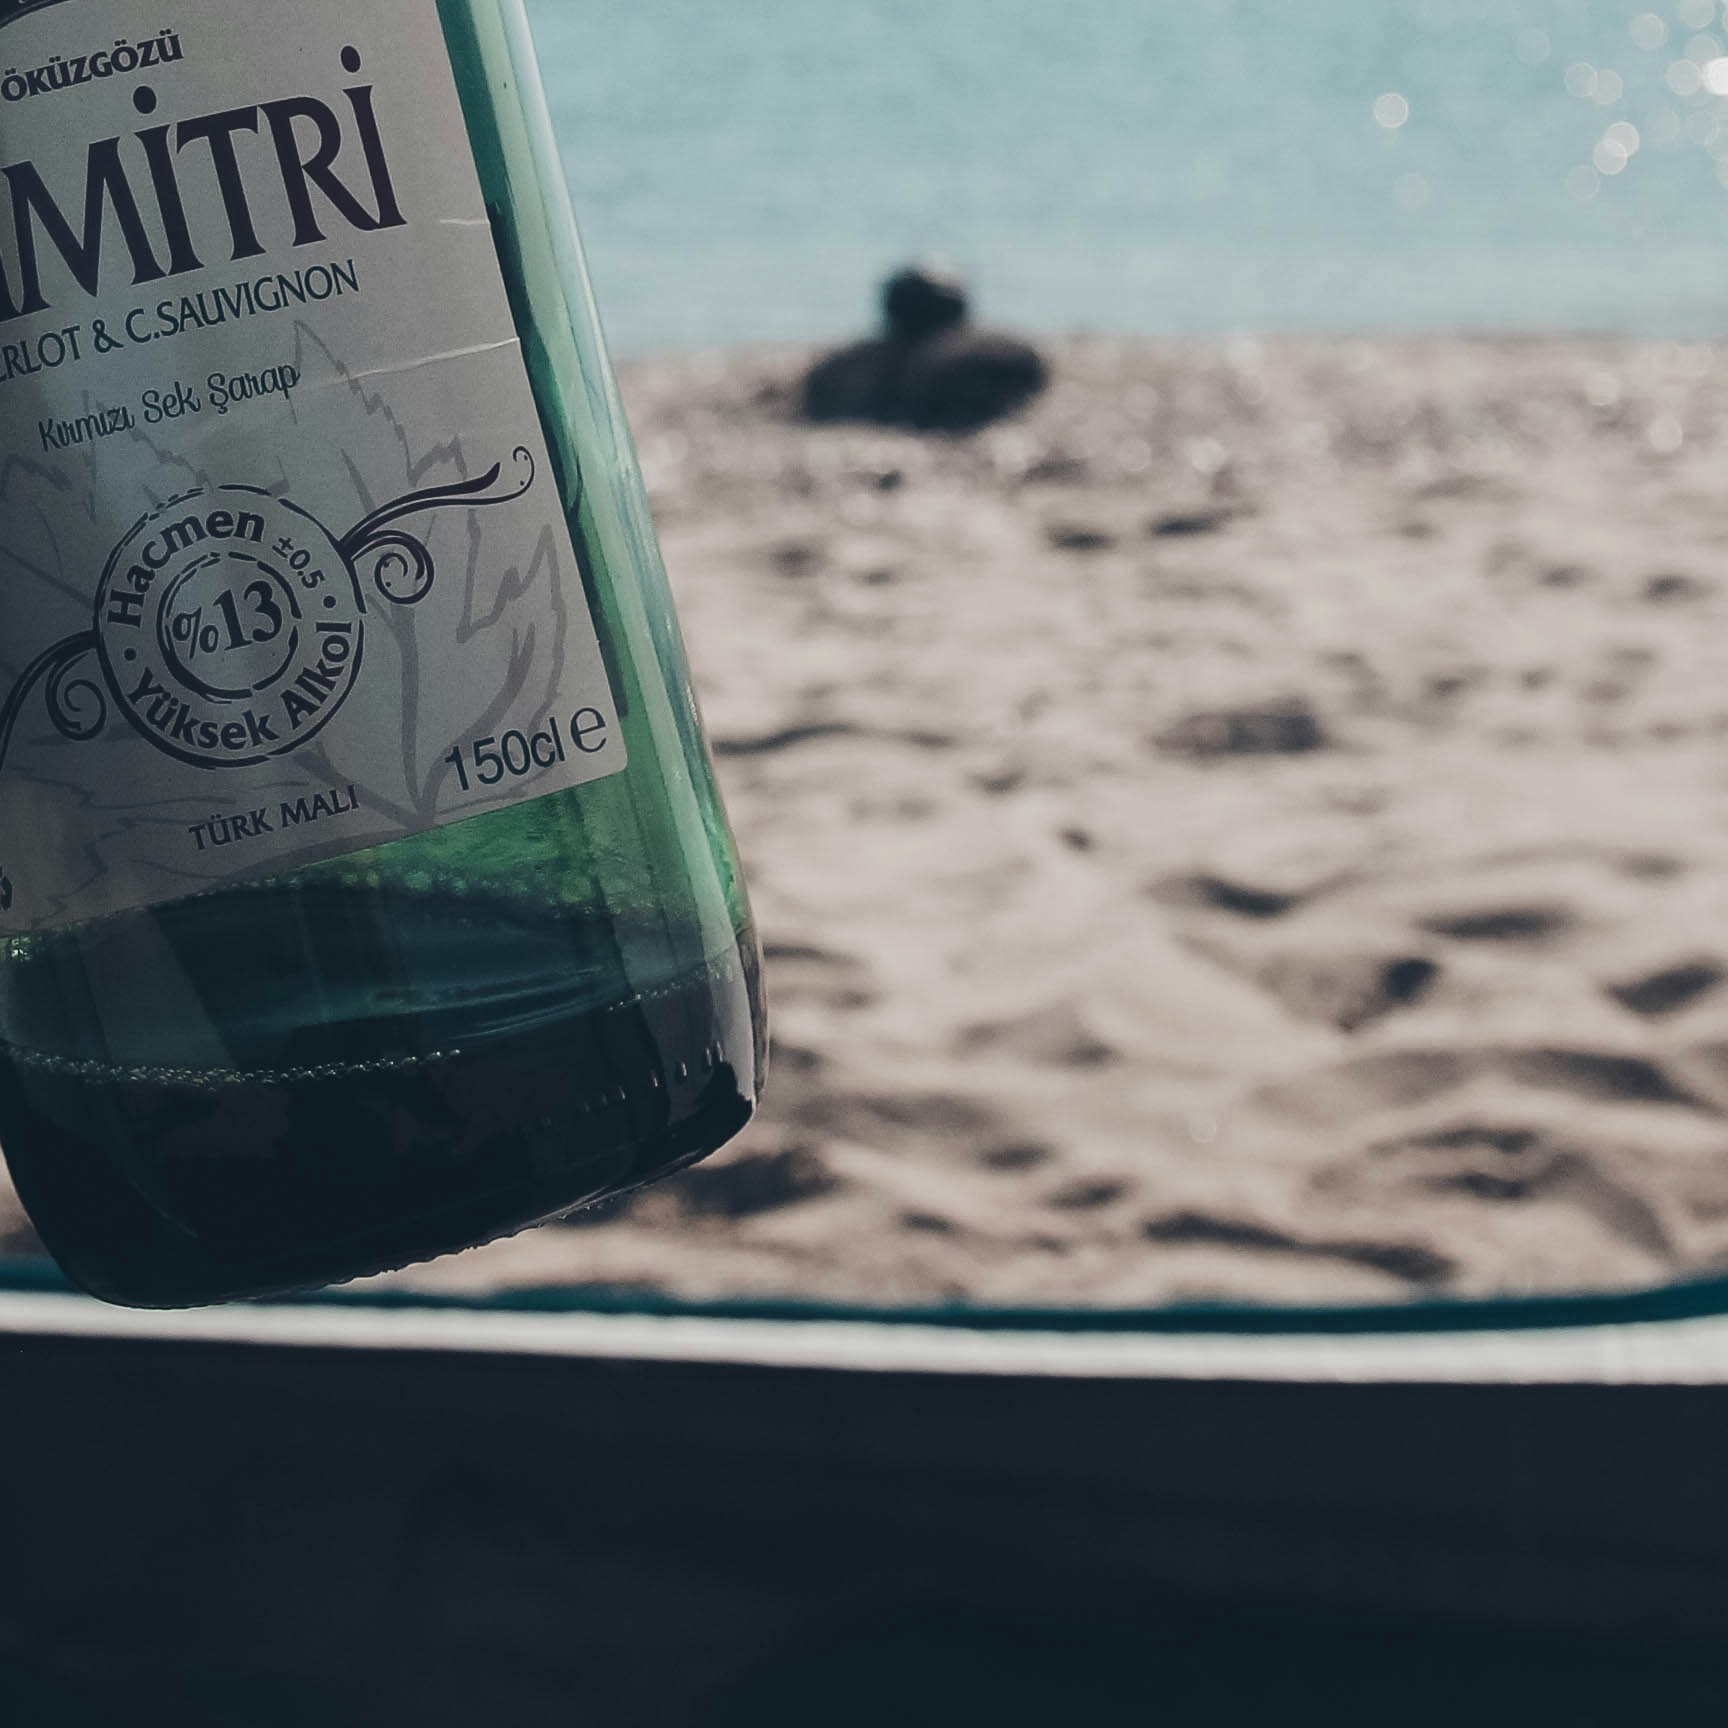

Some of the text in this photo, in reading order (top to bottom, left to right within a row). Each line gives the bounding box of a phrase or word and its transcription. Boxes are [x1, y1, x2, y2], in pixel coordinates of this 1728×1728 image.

[0, 28, 185, 102] ÖKÜZGÖZÜ
[92, 318, 124, 354] &
[125, 259, 360, 345] C.SAUVIGNON
[38, 362, 302, 452] Kırmızı Sek Şarap
[107, 509, 266, 628] Hacmen
[171, 580, 283, 660] %13
[127, 621, 353, 751] Yüksek Alkol
[188, 784, 361, 850] TÜRK MALI
